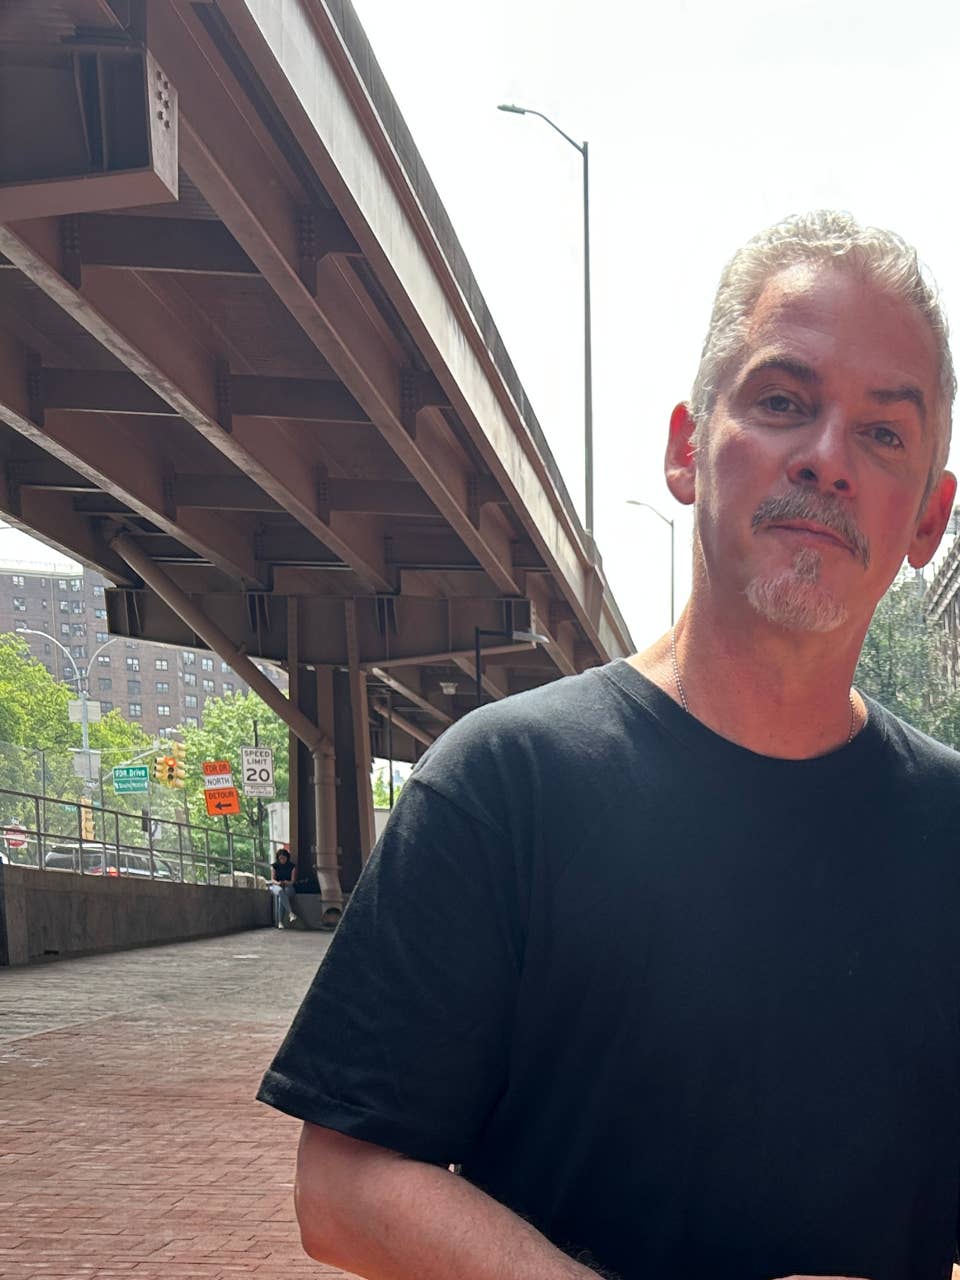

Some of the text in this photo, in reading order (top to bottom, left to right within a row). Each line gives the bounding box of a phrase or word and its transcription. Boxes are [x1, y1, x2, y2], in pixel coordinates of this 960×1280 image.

[244, 750, 270, 758] SPEED
[129, 768, 146, 777] Drive
[246, 768, 270, 782] 20
[207, 777, 231, 786] NORTH
[208, 791, 234, 800] DETOUR
